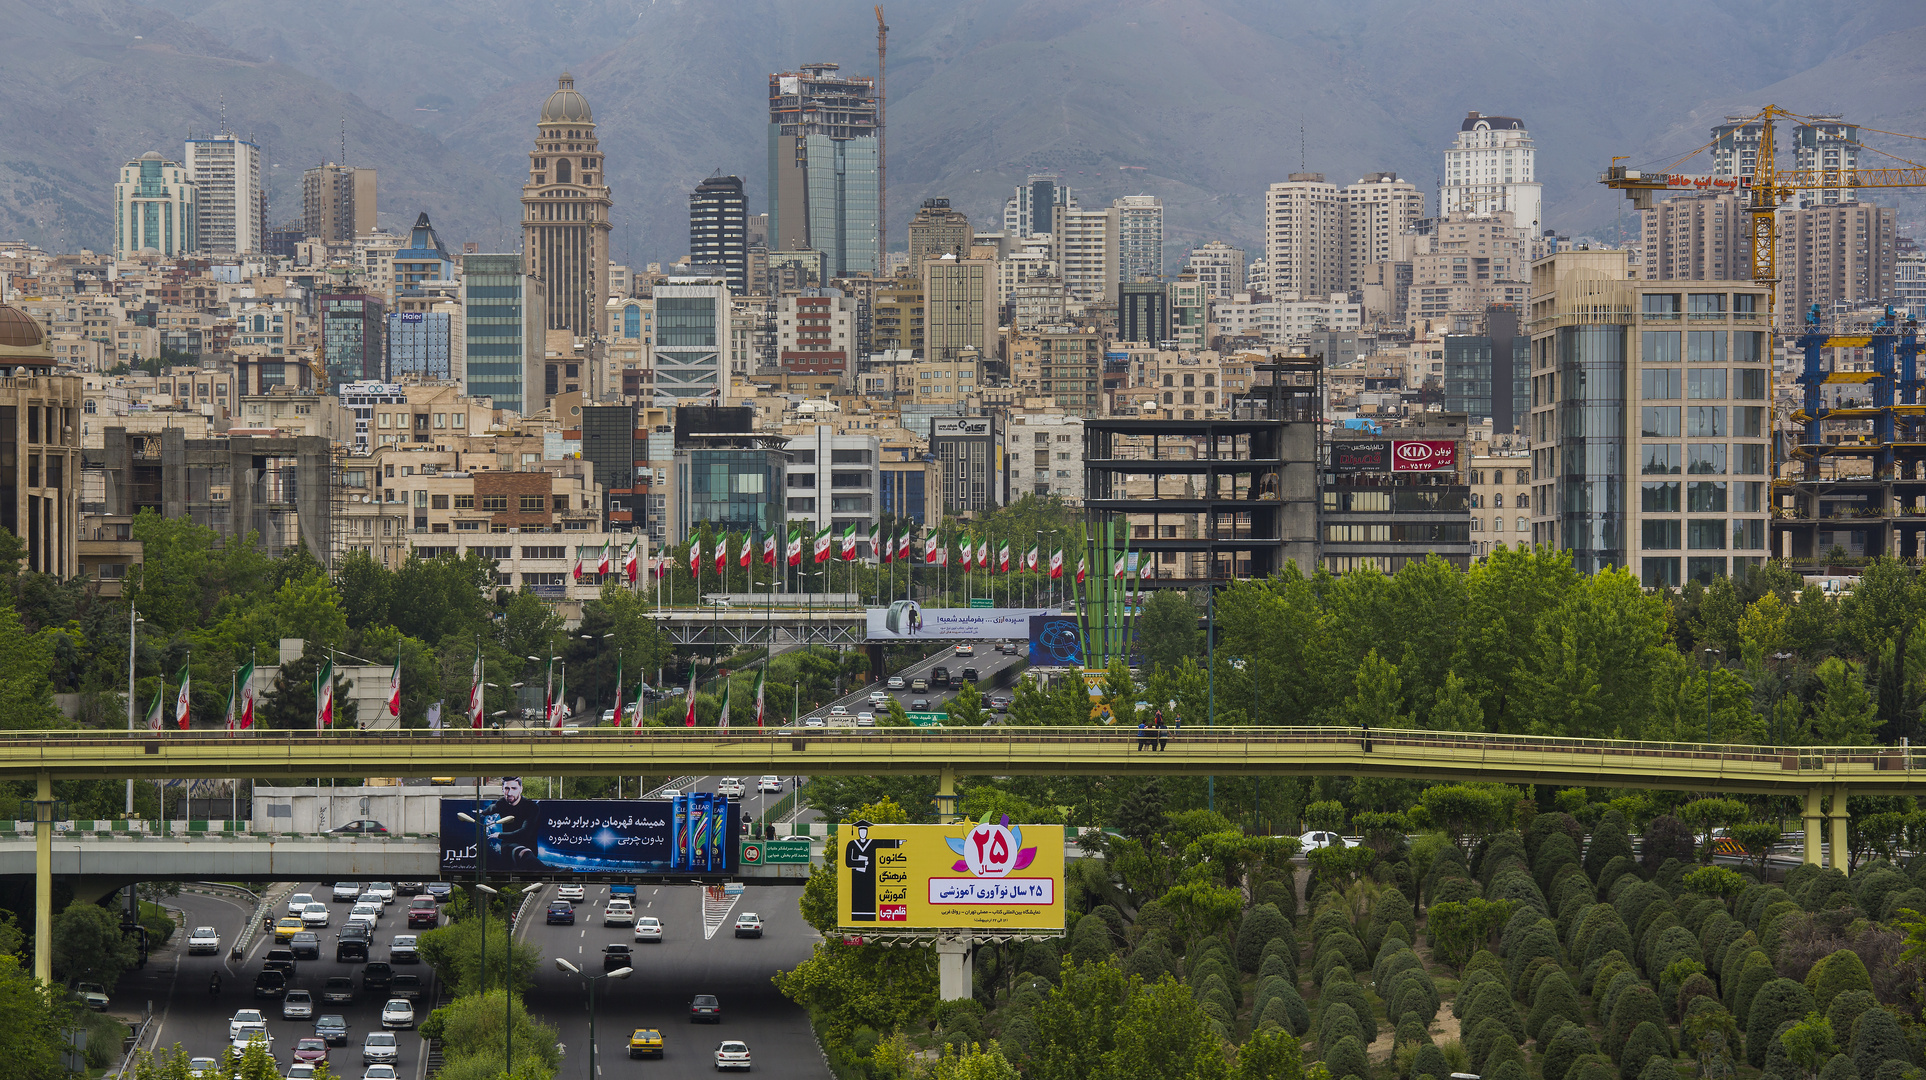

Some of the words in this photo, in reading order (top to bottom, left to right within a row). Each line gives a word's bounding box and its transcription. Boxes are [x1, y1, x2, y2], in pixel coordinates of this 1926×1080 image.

[1668, 174, 1691, 186] حافظ
[1694, 176, 1712, 190] ابنیه
[1713, 176, 1738, 190] توسعه
[1403, 447, 1426, 457] KIA
[959, 615, 984, 624] بفرمایید
[548, 816, 571, 828] شوره
[571, 816, 589, 828] برابر
[590, 818, 600, 828] در
[602, 816, 633, 829] قهرمان
[634, 817, 666, 829] همیشه
[973, 829, 1009, 865] ۲۵
[879, 853, 907, 864] کانون
[978, 865, 1003, 875] سال
[879, 871, 907, 882] فرهنگی
[879, 888, 907, 902] آموزش
[940, 884, 975, 898] آموزشی
[977, 884, 1008, 899] نوآوری
[1010, 886, 1027, 898] سال
[1029, 885, 1042, 896] ۲۵
